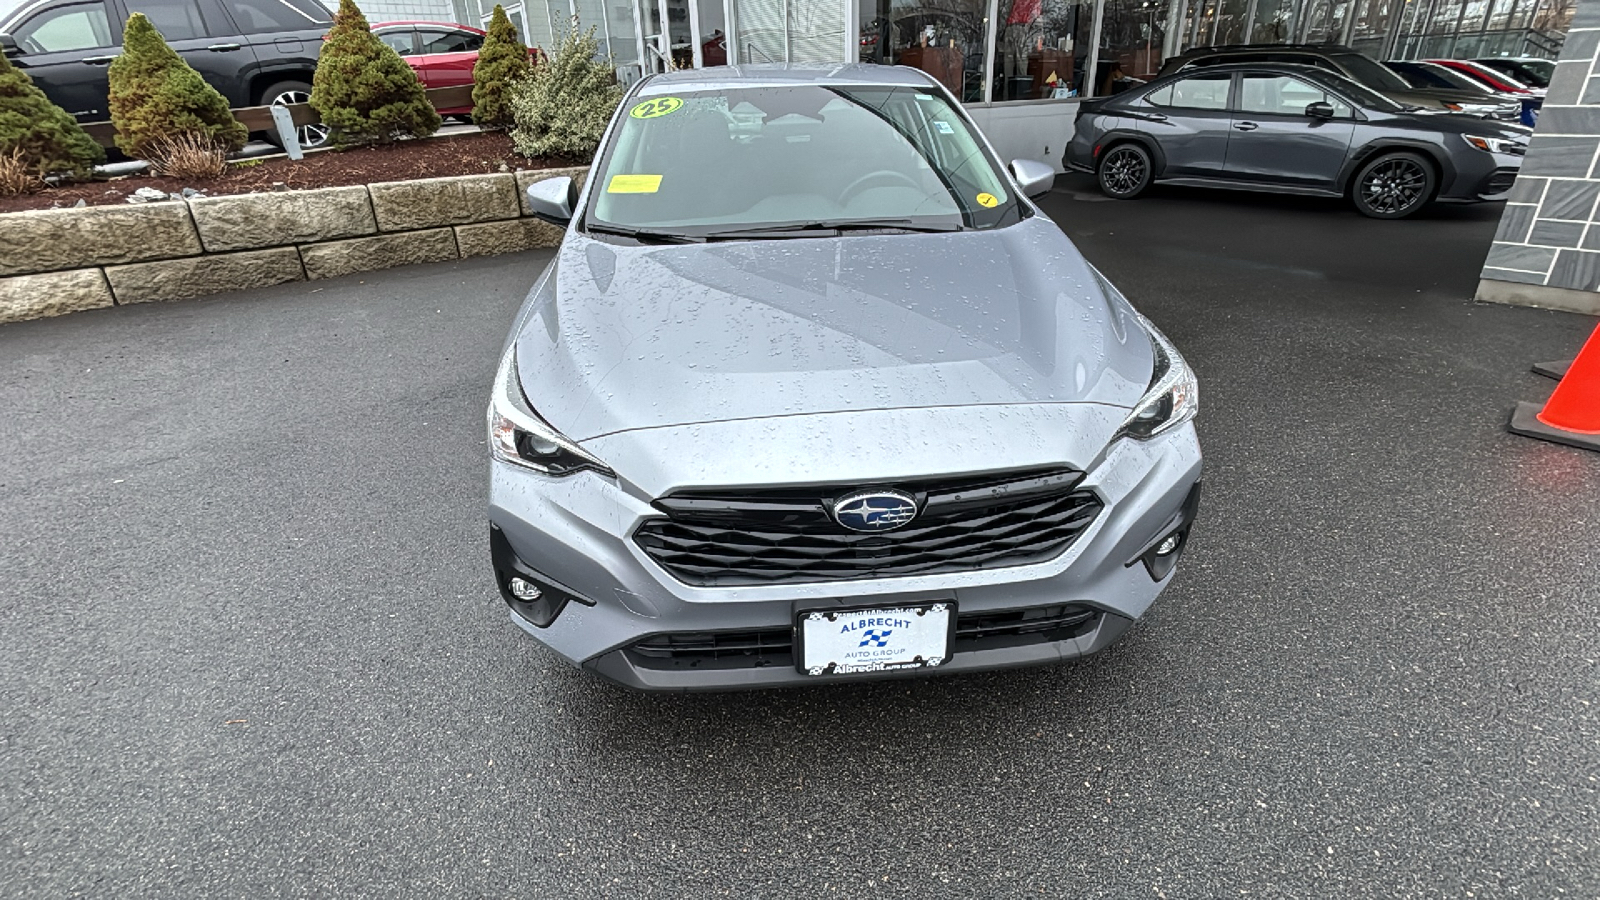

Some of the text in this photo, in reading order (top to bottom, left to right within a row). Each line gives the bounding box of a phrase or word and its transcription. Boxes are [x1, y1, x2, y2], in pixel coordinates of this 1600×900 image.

[640, 98, 672, 117] 25
[840, 617, 912, 634] ALBRECHT
[844, 648, 906, 659] AUTO GROUP
[833, 661, 886, 674] Albrecht
